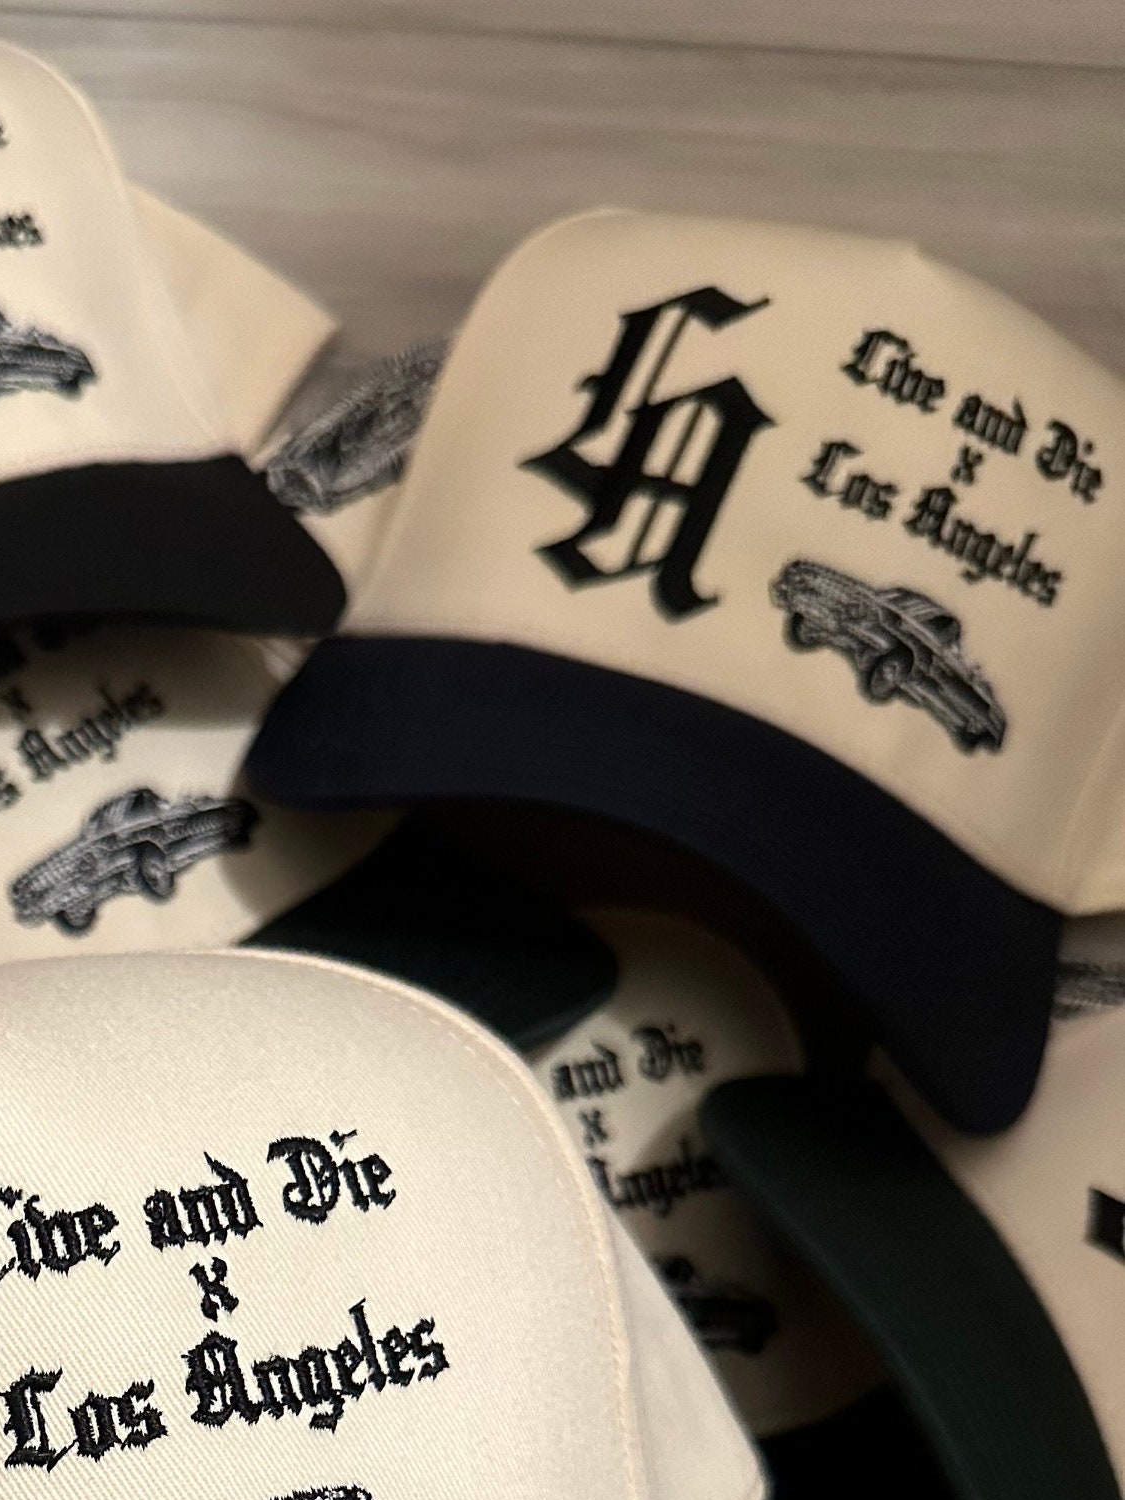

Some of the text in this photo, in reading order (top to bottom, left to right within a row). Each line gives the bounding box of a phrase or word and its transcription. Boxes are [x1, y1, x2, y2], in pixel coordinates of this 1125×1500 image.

[841, 328, 1105, 506] Live and Die
[799, 440, 1063, 607] Los Angeles
[15, 682, 166, 781] Angeles
[143, 1151, 264, 1252] and
[266, 1129, 398, 1225] Die
[189, 1255, 240, 1322] x
[1, 1297, 452, 1472] Los Angeles
